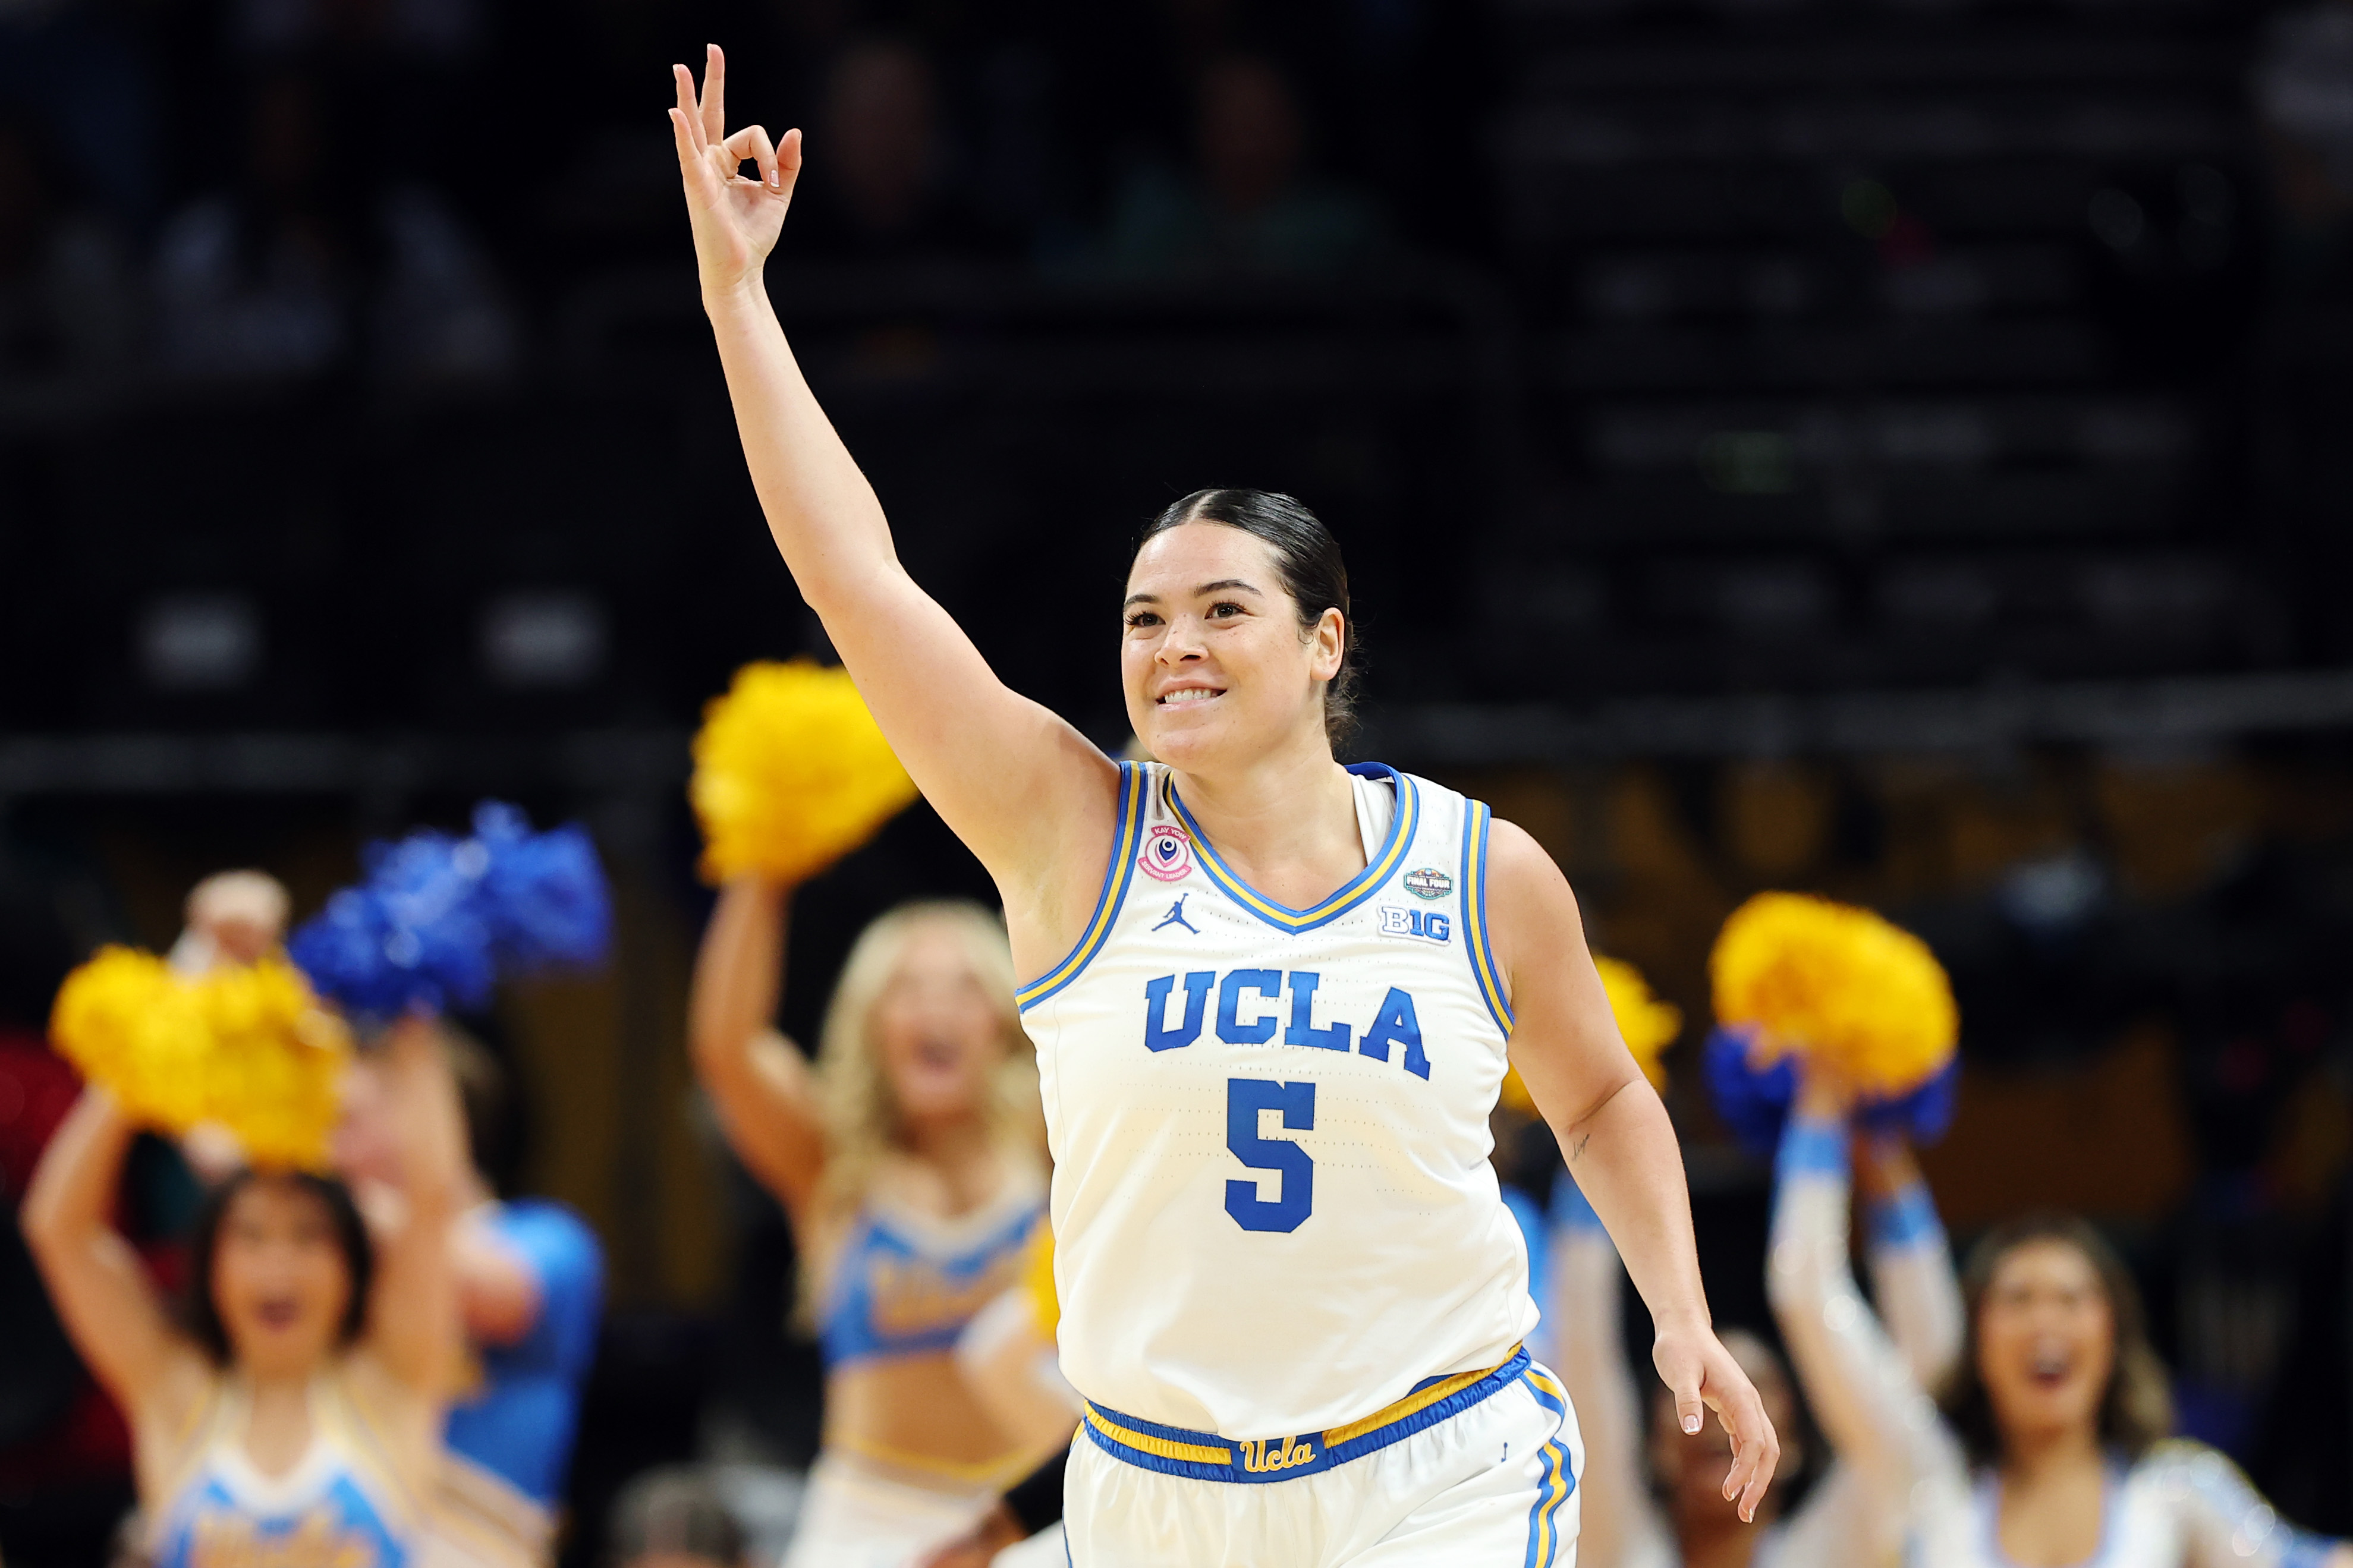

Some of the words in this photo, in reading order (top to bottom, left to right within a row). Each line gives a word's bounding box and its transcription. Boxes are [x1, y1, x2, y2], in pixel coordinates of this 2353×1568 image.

[1171, 828, 1187, 840] YOW
[1141, 861, 1165, 878] SERVANT
[1166, 868, 1188, 879] LEADER
[1407, 876, 1429, 887] FINAL
[1429, 879, 1450, 889] FOUR
[1145, 969, 1430, 1081] UCLA
[1225, 1078, 1316, 1233] 5
[1240, 1435, 1316, 1472] Ucla
